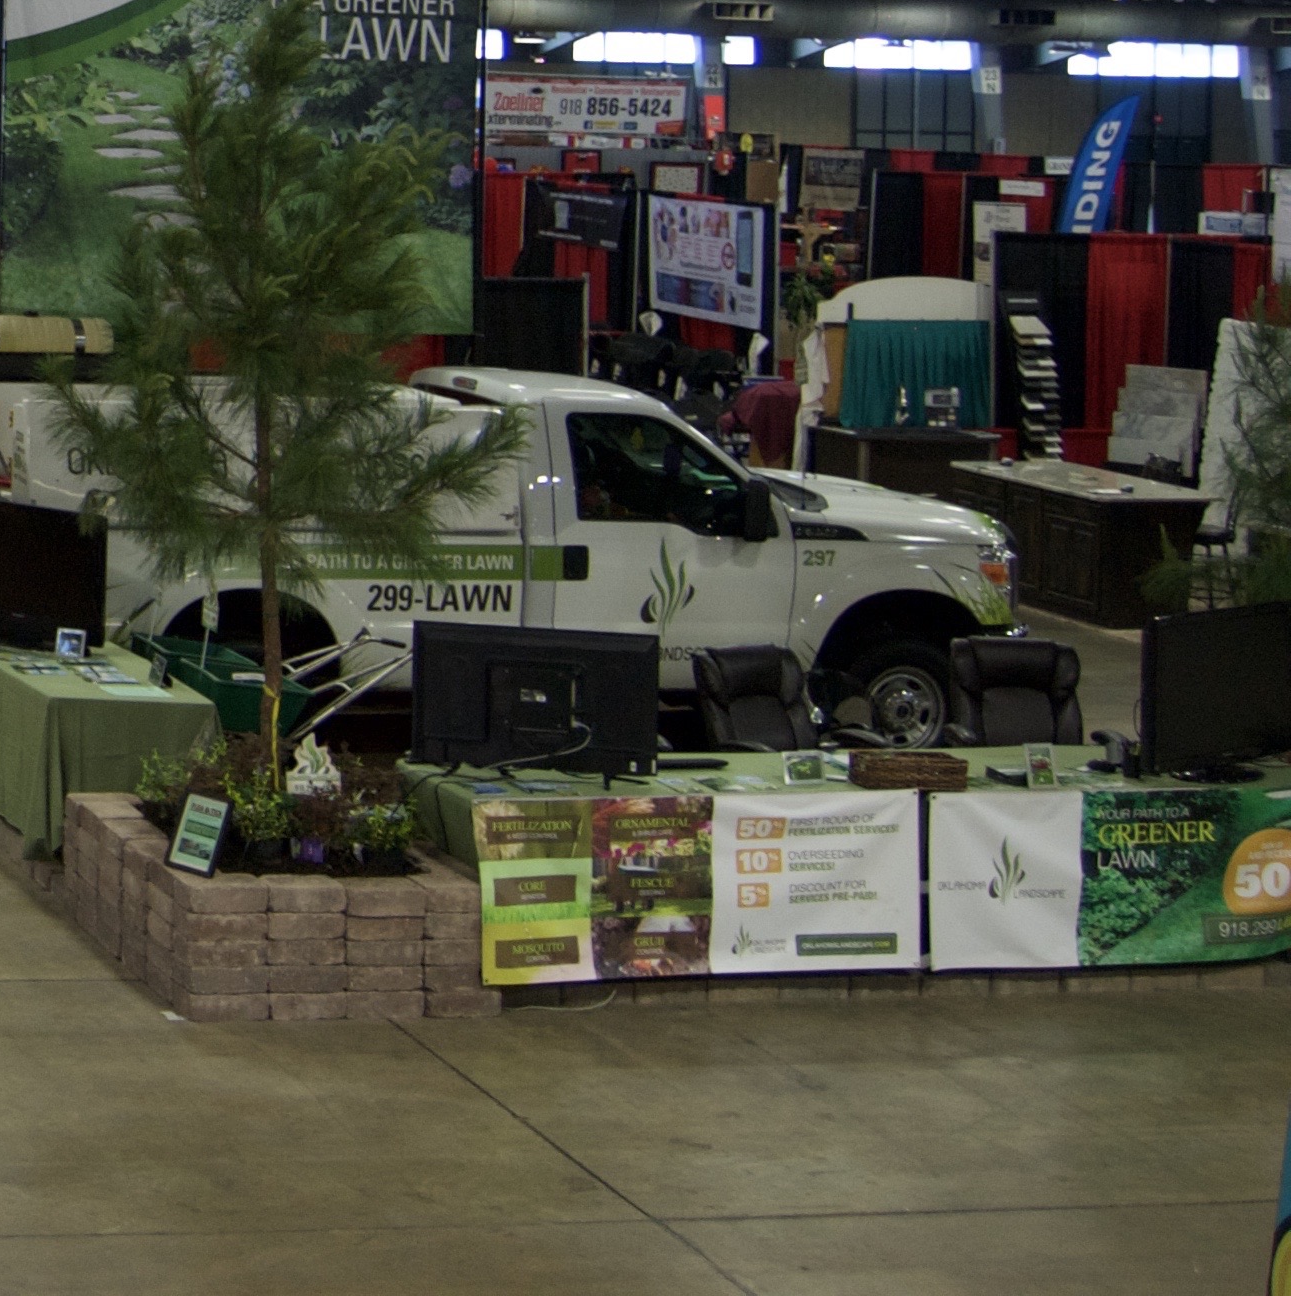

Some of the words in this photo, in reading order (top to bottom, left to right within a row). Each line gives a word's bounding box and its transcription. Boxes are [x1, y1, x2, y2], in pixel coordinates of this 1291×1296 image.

[320, 16, 452, 64] LAWN
[493, 92, 544, 112] Zoellner
[559, 98, 582, 115] 918
[587, 97, 672, 117] 856-5424
[306, 554, 348, 570] PATH
[351, 554, 373, 570] TO
[376, 555, 389, 571] A
[466, 554, 514, 572] LAWN
[802, 549, 836, 567] 297
[367, 584, 513, 612] 299-LAWN
[790, 817, 820, 826] FIRST
[822, 815, 860, 825] ROUND
[862, 813, 877, 823] OF
[1097, 810, 1131, 820] YOUR
[1133, 808, 1163, 819] PATH
[1165, 807, 1180, 818] TO
[1180, 807, 1189, 818] A
[491, 819, 573, 832] FERTILIZATION
[614, 817, 691, 829] ORNAMENTAL
[738, 819, 783, 837] 50%
[788, 826, 851, 836] FERTILIZATION
[853, 824, 900, 834] SERVICES!
[1098, 820, 1217, 847] GREENER
[788, 848, 865, 860] OVERSEEDING
[1096, 850, 1157, 870] LAWN
[739, 851, 780, 871] 10%
[788, 862, 835, 872] SERVICES!
[518, 881, 546, 892] CORE
[630, 877, 674, 889] FESCUE
[789, 881, 842, 893] DISCOUNT
[844, 880, 867, 889] FOR
[937, 881, 986, 891] OKLAHOMA
[740, 886, 768, 906] 5%
[789, 894, 830, 904] SERVICES
[1014, 888, 1067, 899] LANDSCAPE
[511, 942, 565, 955] MOSQUITO
[634, 937, 666, 948] GRUB
